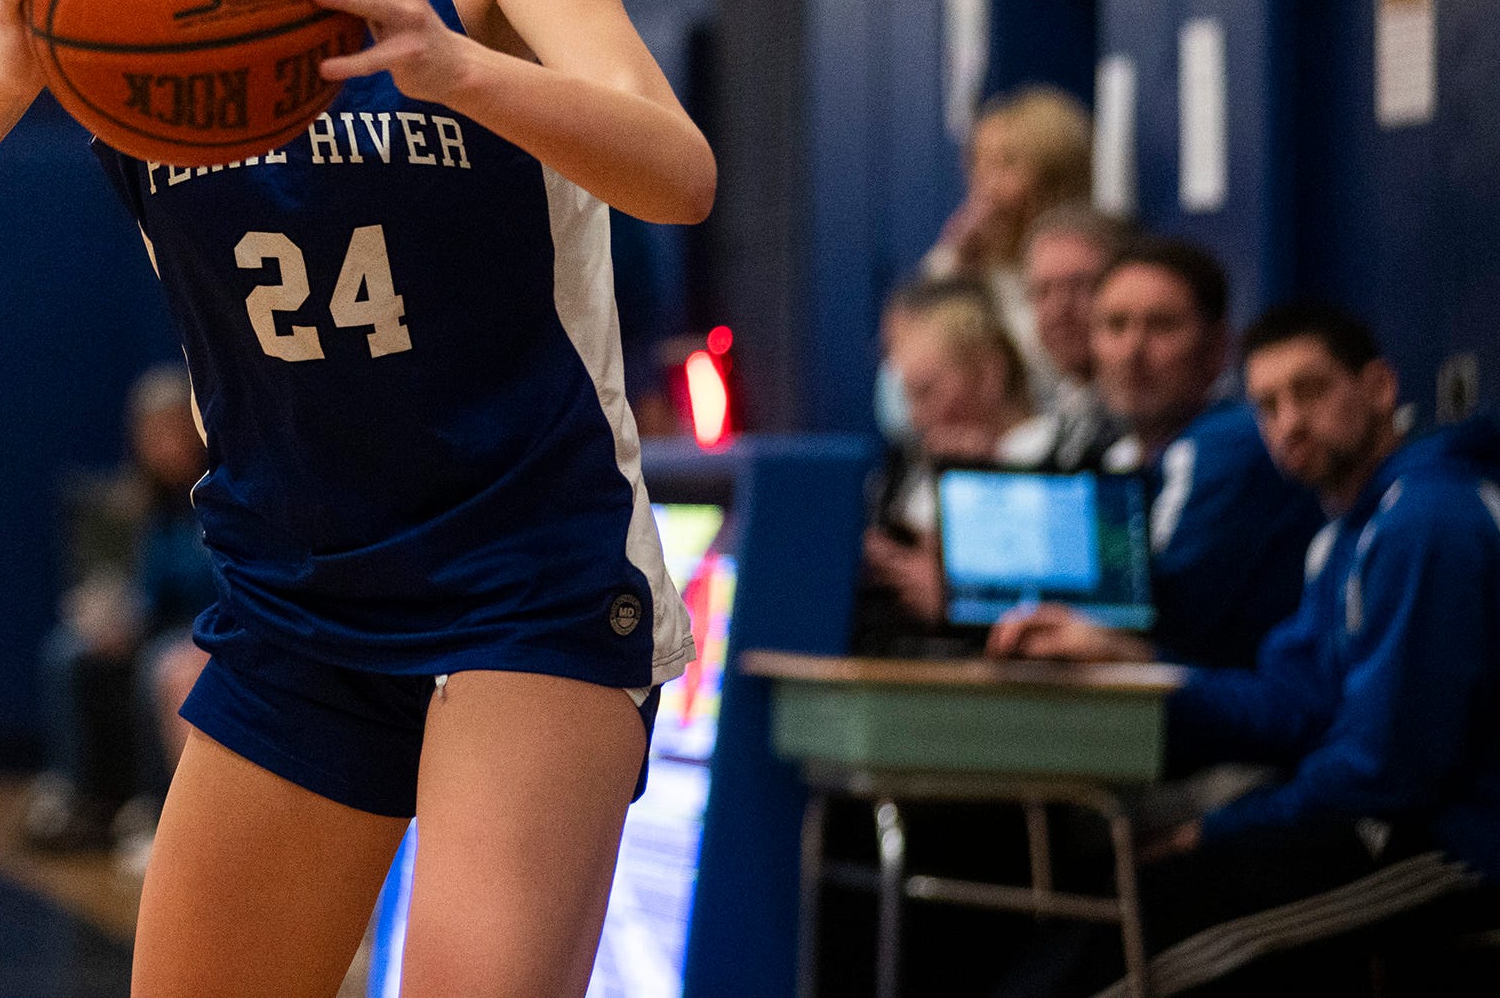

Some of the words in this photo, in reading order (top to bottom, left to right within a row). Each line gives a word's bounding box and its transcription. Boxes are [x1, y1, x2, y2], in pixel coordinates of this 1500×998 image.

[123, 69, 250, 131] ROCK
[308, 111, 472, 170] RIVER
[233, 223, 413, 363] 24
